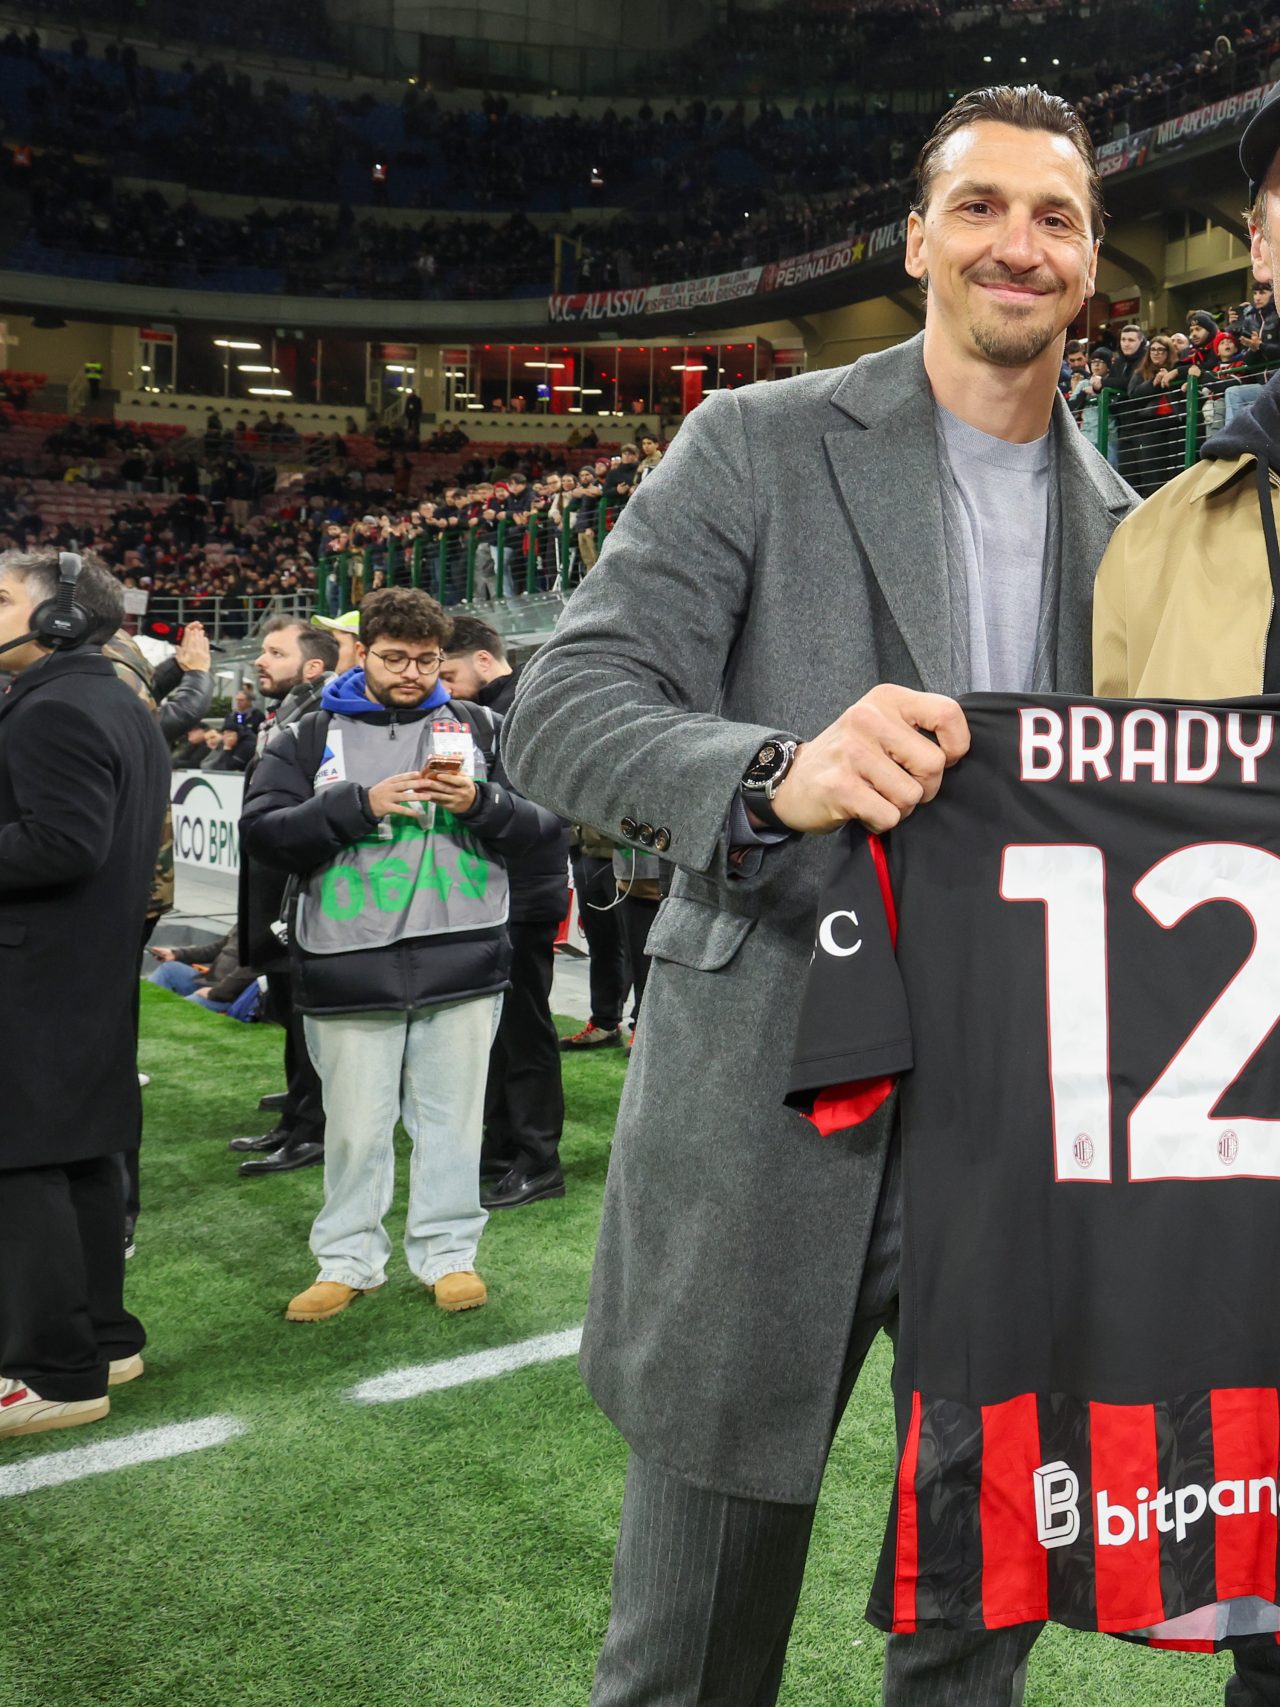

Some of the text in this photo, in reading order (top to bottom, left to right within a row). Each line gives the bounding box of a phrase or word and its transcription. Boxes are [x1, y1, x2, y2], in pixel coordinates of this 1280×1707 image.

[1157, 112, 1198, 144] MILAN
[1201, 97, 1238, 128] CLUB
[775, 248, 851, 288] PERINALDO
[580, 287, 647, 320] ALASSIO
[1019, 705, 1275, 784] BRADY
[320, 848, 490, 921] 0649
